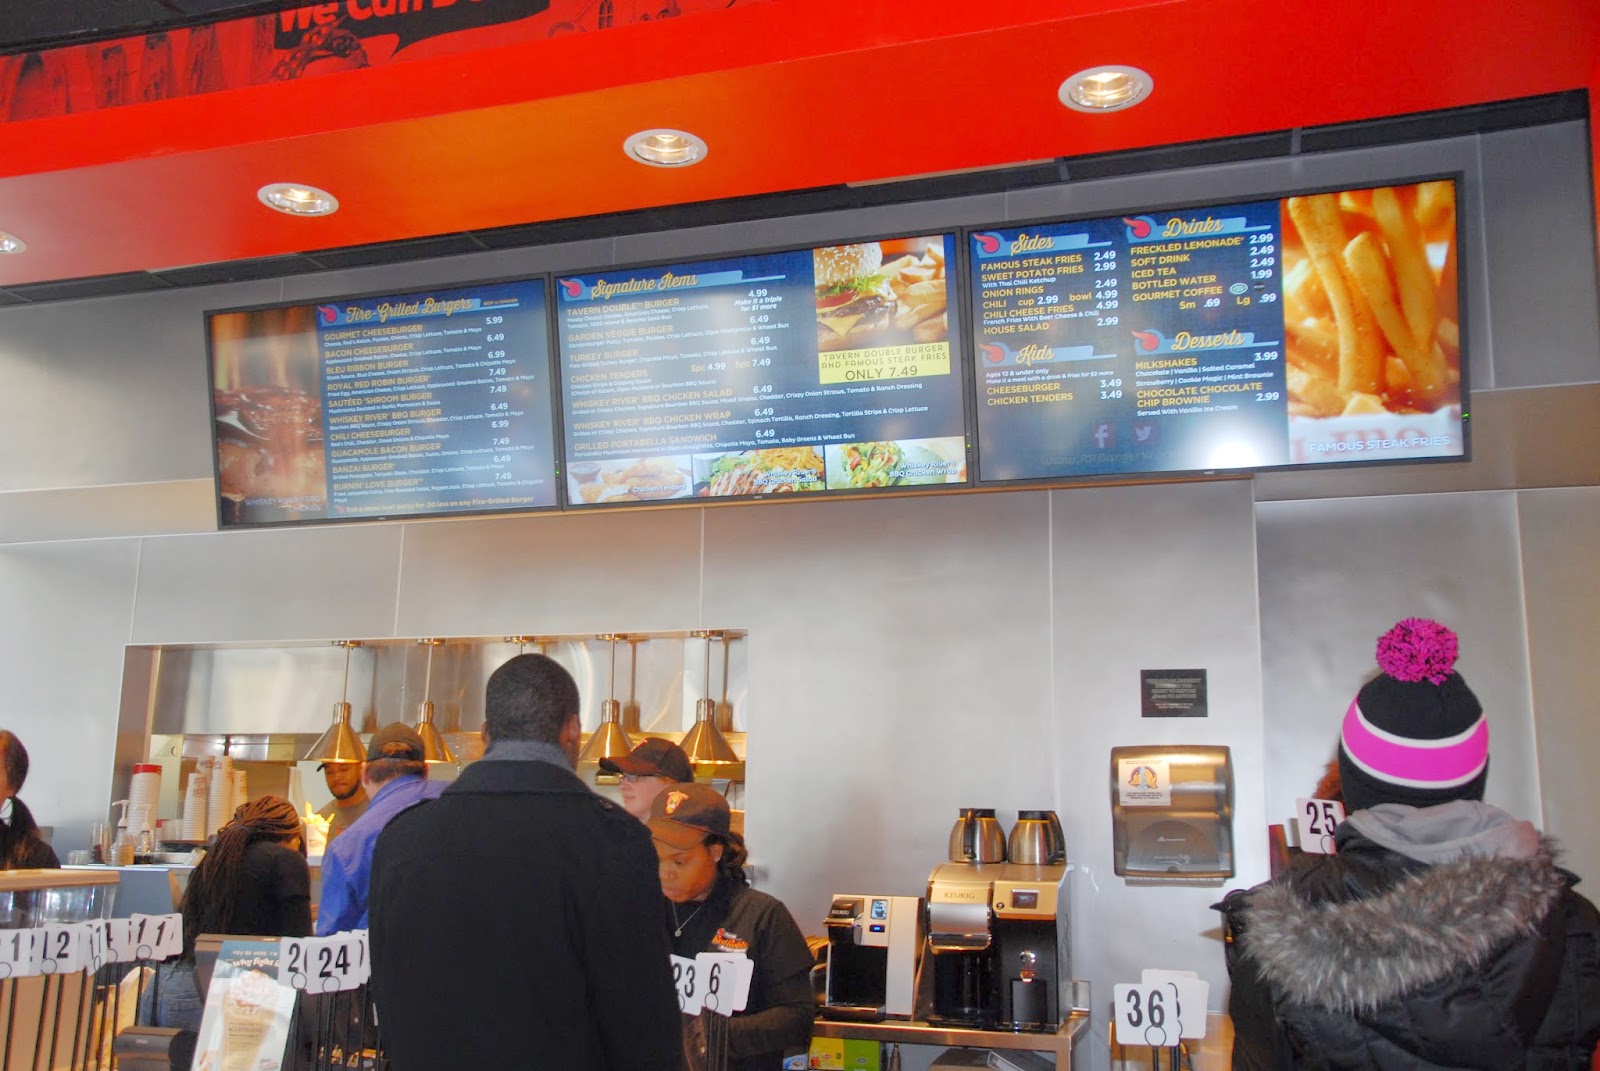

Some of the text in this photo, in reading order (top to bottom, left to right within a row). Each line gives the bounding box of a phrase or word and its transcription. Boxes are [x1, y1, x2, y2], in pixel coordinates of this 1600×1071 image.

[278, 1, 339, 33] We
[1162, 216, 1223, 237] Drinks
[1010, 233, 1055, 256] Sides
[1130, 242, 1181, 255] FRECKLED
[1249, 232, 1273, 244] 2.99
[981, 250, 1116, 271] FAMOUS STEAK FRIES 2.49
[1131, 244, 1274, 266] SOFT DRINK 2.49
[981, 261, 1116, 282] SWEET POTATO FRIES 2.99
[1131, 256, 1274, 278] ICED TEA 2.49
[591, 271, 698, 300] Signature Items
[982, 278, 1117, 298] ONION RINGS 2.49
[1132, 268, 1272, 289] BOTTLED WATER 1.99
[566, 288, 767, 316] TAVERN BURGER 4.99
[982, 289, 1117, 309] CHILI cup 2.99 bowl 4.99
[1132, 289, 1181, 301] GOURMET
[1183, 285, 1223, 297] COFFEE
[1179, 300, 1195, 309] Sm
[1236, 295, 1250, 306] Lg
[346, 297, 473, 323] Fire-Grilled Burgers
[983, 300, 1118, 319] CHILI CHEESE FRIES 4.99
[324, 315, 503, 341] GOURMET CHEESEBURGER 5.99
[568, 314, 768, 342] GARDEN VEGGIE BURGER 6.49
[984, 316, 1118, 335] HOUSE SALAD 2.99
[325, 332, 504, 358] BACON CHEESEBURGER 6.49
[569, 336, 769, 362] TURKEY BURGER 6.49
[1171, 329, 1244, 350] Desserts
[326, 350, 505, 374] BLEU RIBBON BURGER 6.99
[821, 352, 947, 369] AND FAMOUS STEAK FRIES
[823, 344, 943, 361] TAVERN DOUBLE BURGER
[1015, 343, 1055, 366] Kids
[1135, 351, 1278, 369] MILKSHAKES 3.99
[707, 357, 771, 371] 4.99 7.49
[845, 365, 917, 381] ONLY 7.49
[327, 367, 506, 391] ROYAL RED ROBIN 7.49
[570, 369, 647, 383] CHICKEN TENDERS
[986, 378, 1121, 395] CHEESEBURGER 3.49
[400, 385, 507, 401] BURGER 7.49
[571, 384, 772, 409] WHISKEY BBQ CHICKEN SALAD 6.49
[987, 389, 1122, 405] CHICKEN TENDERS 3.49
[1136, 382, 1262, 398] CHOCOLATE CHOCOLATE
[1137, 391, 1279, 407] CHIP BROWNIE 2.99
[329, 402, 508, 424] WHISKEY BBQ BURGER 6.49
[573, 407, 773, 430] WHISKEY BBQ CHICKEN WRAP 6.49
[330, 420, 509, 441] CHILI CHEESEBURGER 6.99
[574, 428, 775, 451] GRILLED PORTABELLA SANDWICH 6.49
[331, 437, 510, 457] GUACAMOLE BACON BURGER 7.49
[1309, 435, 1450, 452] FAMOUS STEAK FRIES
[332, 454, 511, 474] BANZAI 6.49
[365, 472, 511, 488] LOVE 7.49
[1306, 801, 1336, 836] 25
[944, 892, 975, 900] KEURIG
[319, 944, 350, 978] 24
[709, 962, 721, 994] 6
[1126, 989, 1165, 1028] 36
